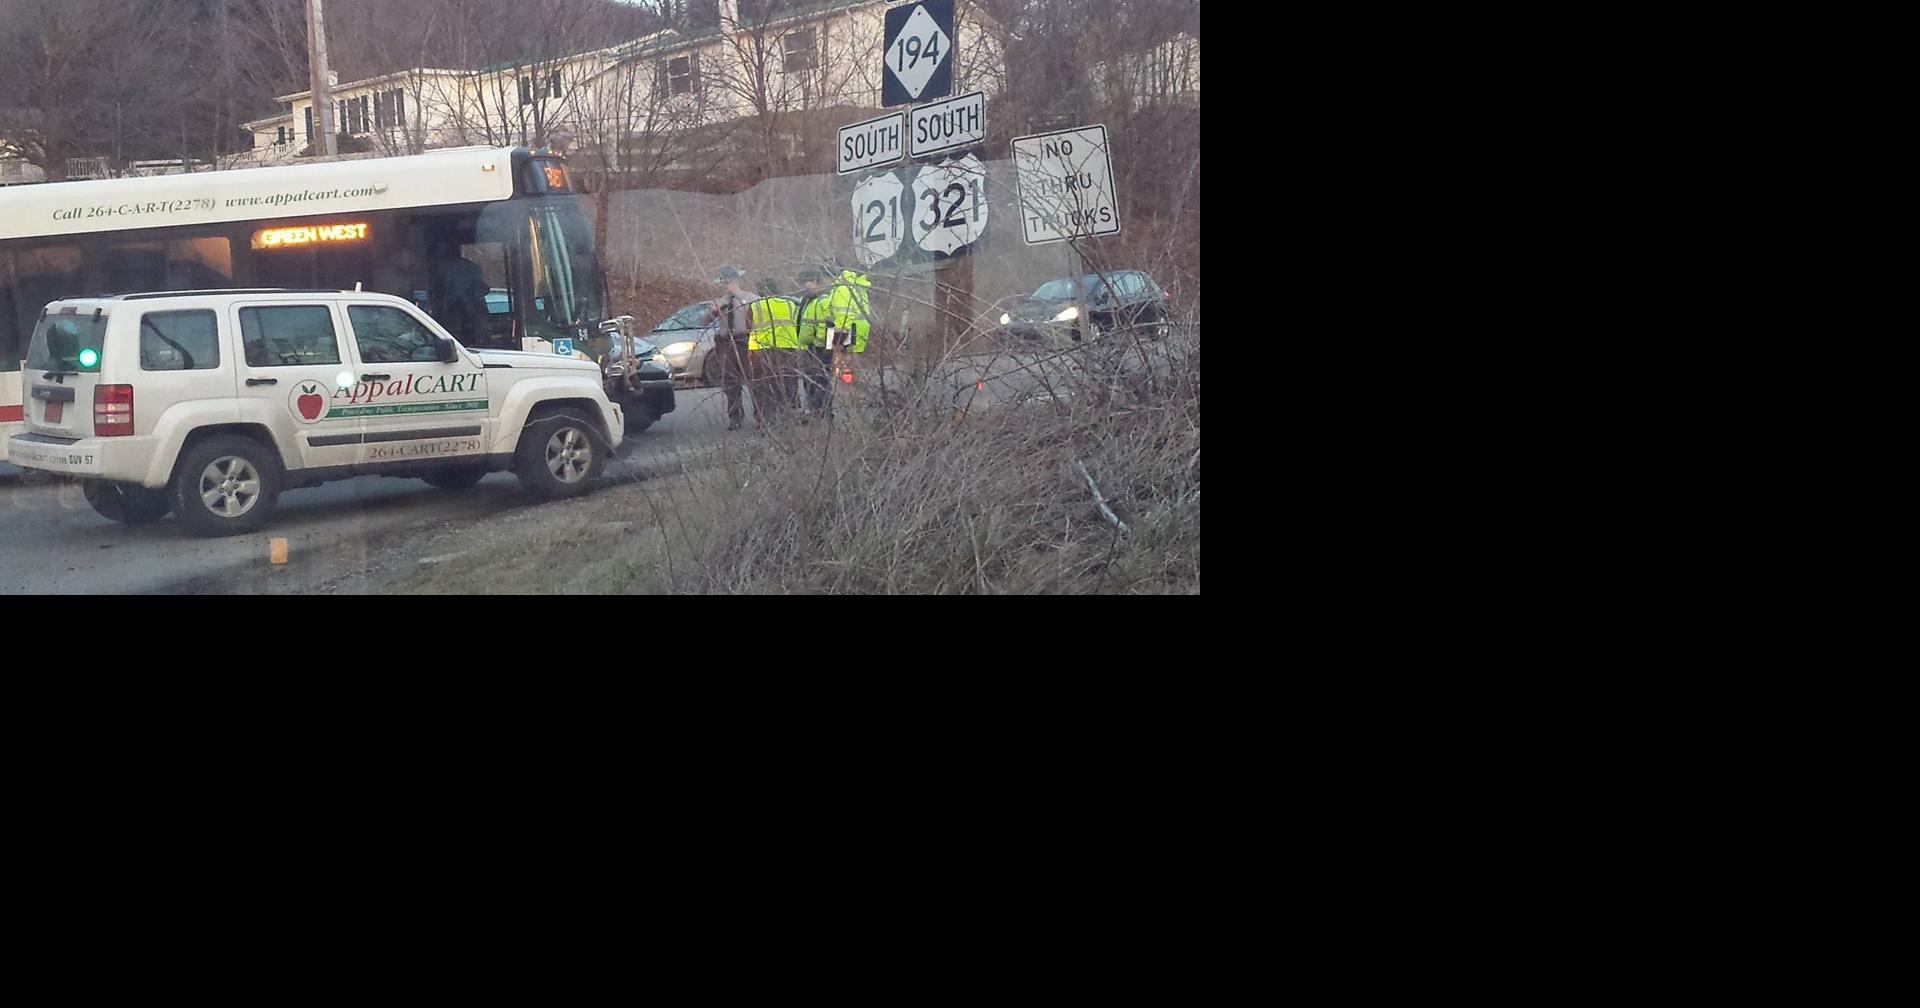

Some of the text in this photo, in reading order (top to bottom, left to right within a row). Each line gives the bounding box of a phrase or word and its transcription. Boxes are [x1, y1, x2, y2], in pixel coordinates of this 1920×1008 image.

[897, 30, 940, 72] 194
[917, 103, 979, 144] SOUTH
[843, 124, 899, 162] SOUTH
[1046, 140, 1073, 159] NO
[1037, 172, 1092, 196] THRU
[53, 187, 373, 221] Call 264-C-A-R-T(2278) www.appalcart.com
[919, 178, 980, 232] 321
[1029, 206, 1111, 233] TRUCKS
[261, 223, 368, 245] GREEN WEST
[333, 373, 484, 404] AppalCART
[370, 440, 481, 459] 264-CART(2278)
